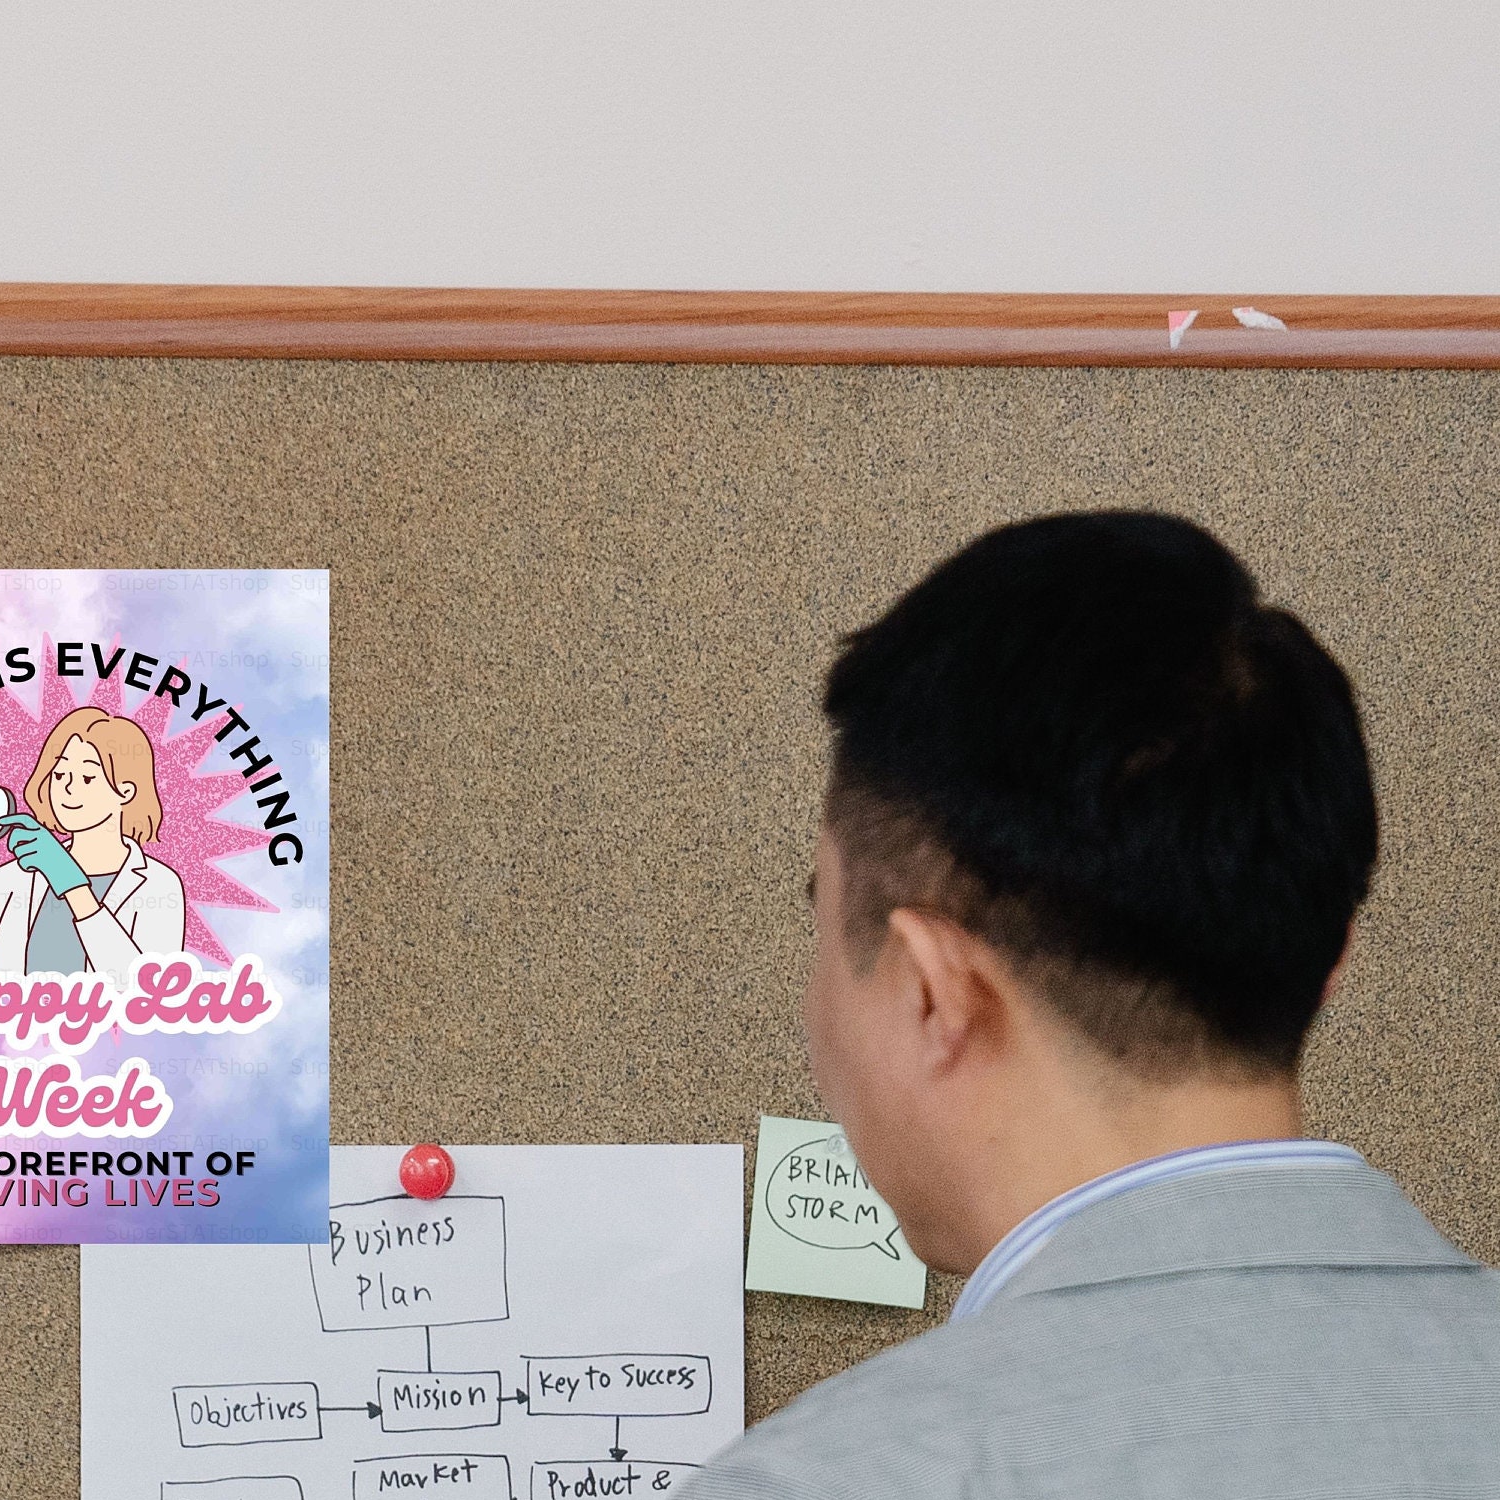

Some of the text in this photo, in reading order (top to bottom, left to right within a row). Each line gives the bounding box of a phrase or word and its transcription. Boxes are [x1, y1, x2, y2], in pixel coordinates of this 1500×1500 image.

[56, 642, 304, 867] EVERYTHING
[125, 961, 272, 1025] Lab
[205, 1151, 256, 1177] OF
[104, 1178, 221, 1207] LIVES
[786, 1194, 879, 1224] STORM
[329, 1216, 454, 1266] Business
[356, 1272, 432, 1311] Plan
[394, 1379, 486, 1411] Mission
[539, 1363, 696, 1402] Key to Success
[190, 1392, 307, 1427] Objectives
[379, 1459, 478, 1491] Market
[547, 1464, 671, 1500] Product &
